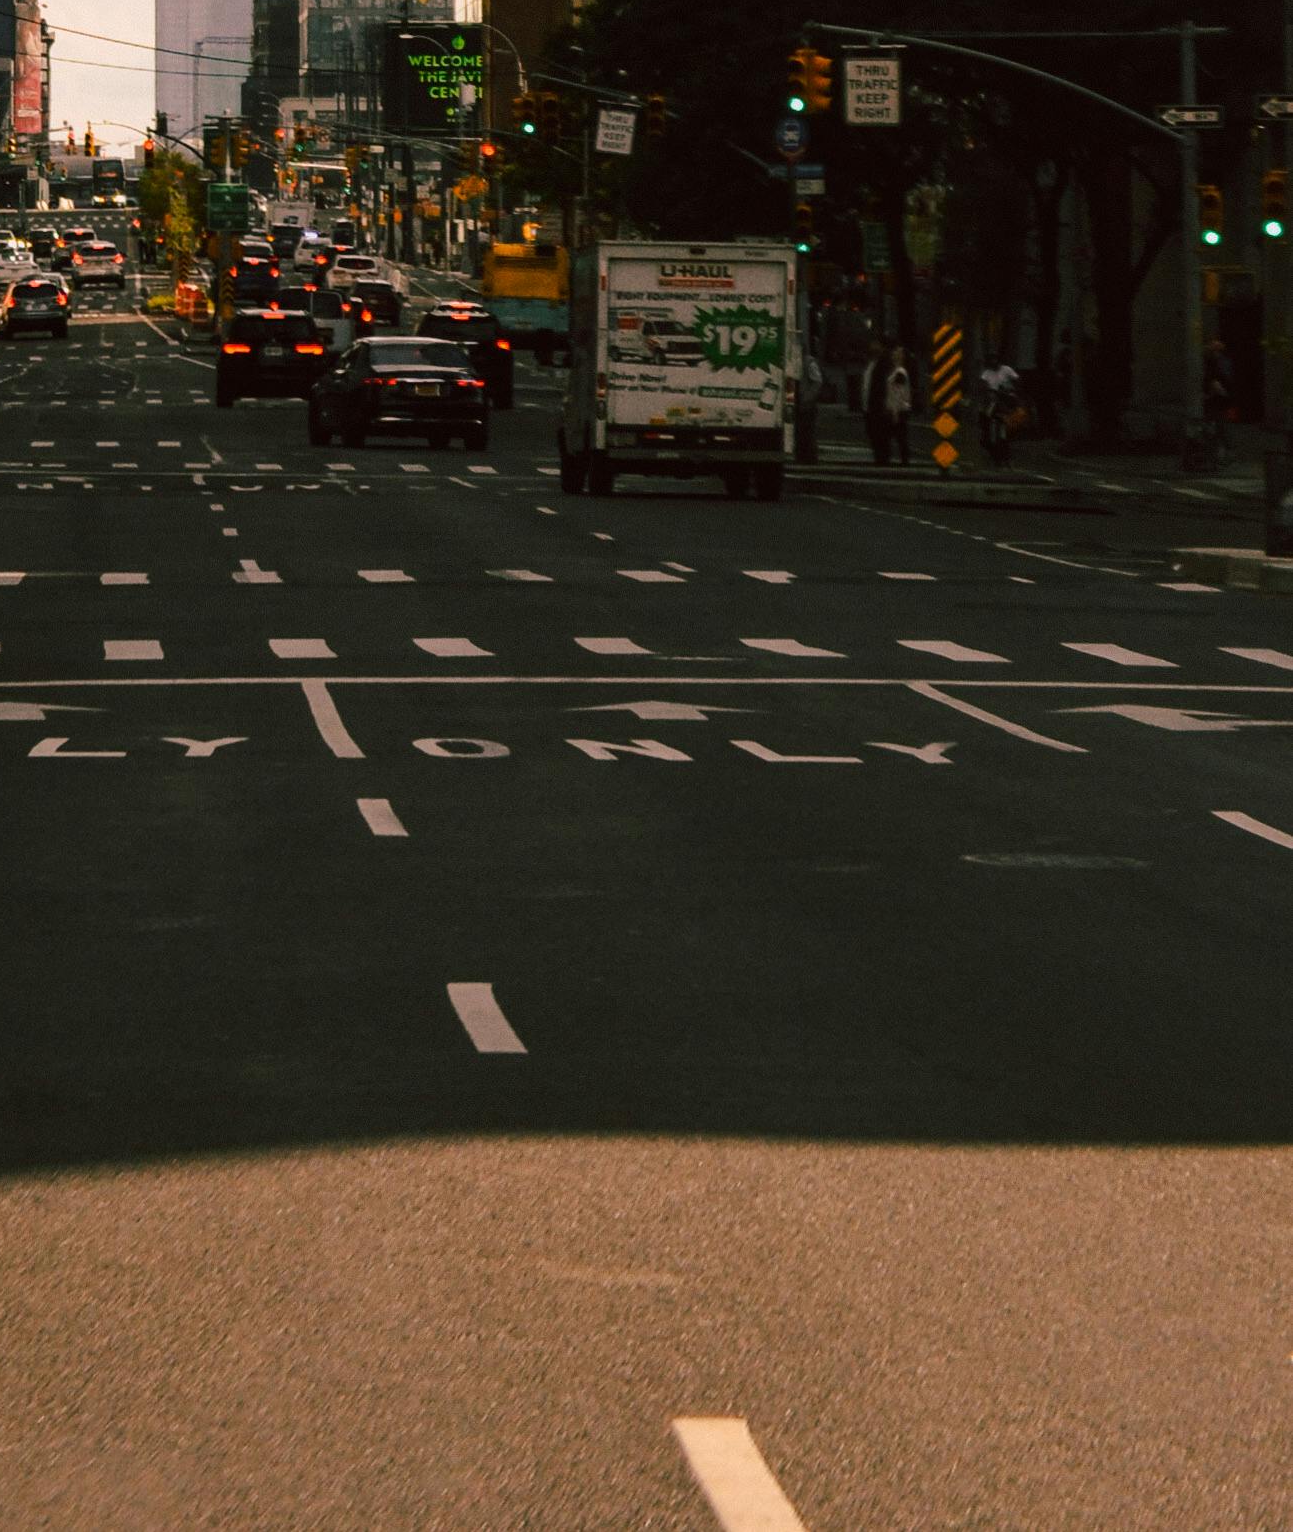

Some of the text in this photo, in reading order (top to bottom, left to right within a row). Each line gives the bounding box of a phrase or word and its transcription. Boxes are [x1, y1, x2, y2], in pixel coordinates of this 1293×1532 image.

[407, 54, 484, 67] WELCOME
[855, 64, 890, 76] THRU
[418, 70, 448, 83] THE
[849, 78, 898, 90] TRAFFIC
[856, 93, 889, 105] KEEP
[855, 107, 891, 119] RIGHT
[411, 737, 958, 765] ONLY
